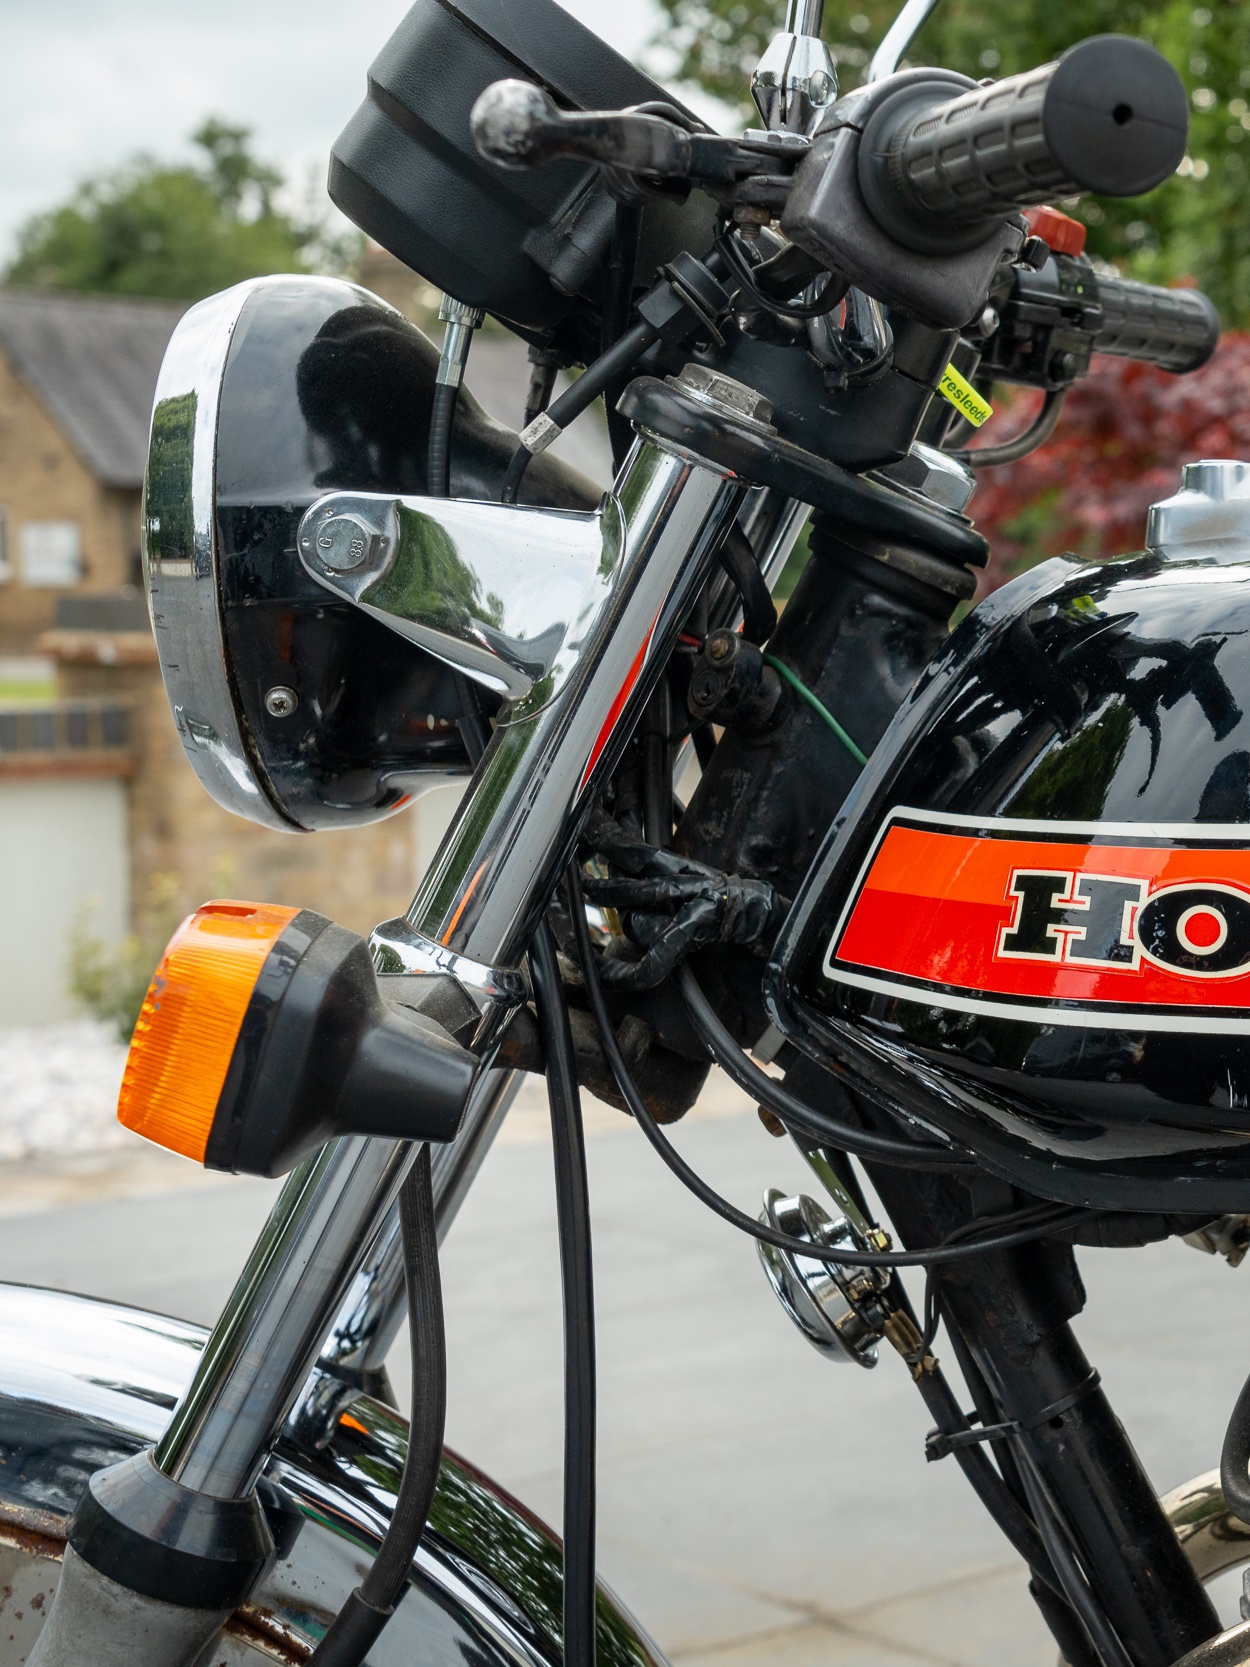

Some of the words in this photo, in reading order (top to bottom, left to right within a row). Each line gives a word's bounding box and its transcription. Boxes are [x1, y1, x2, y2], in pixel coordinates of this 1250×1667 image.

[940, 374, 987, 423] resleeds
[319, 537, 333, 548] G
[350, 539, 364, 557] 8.8
